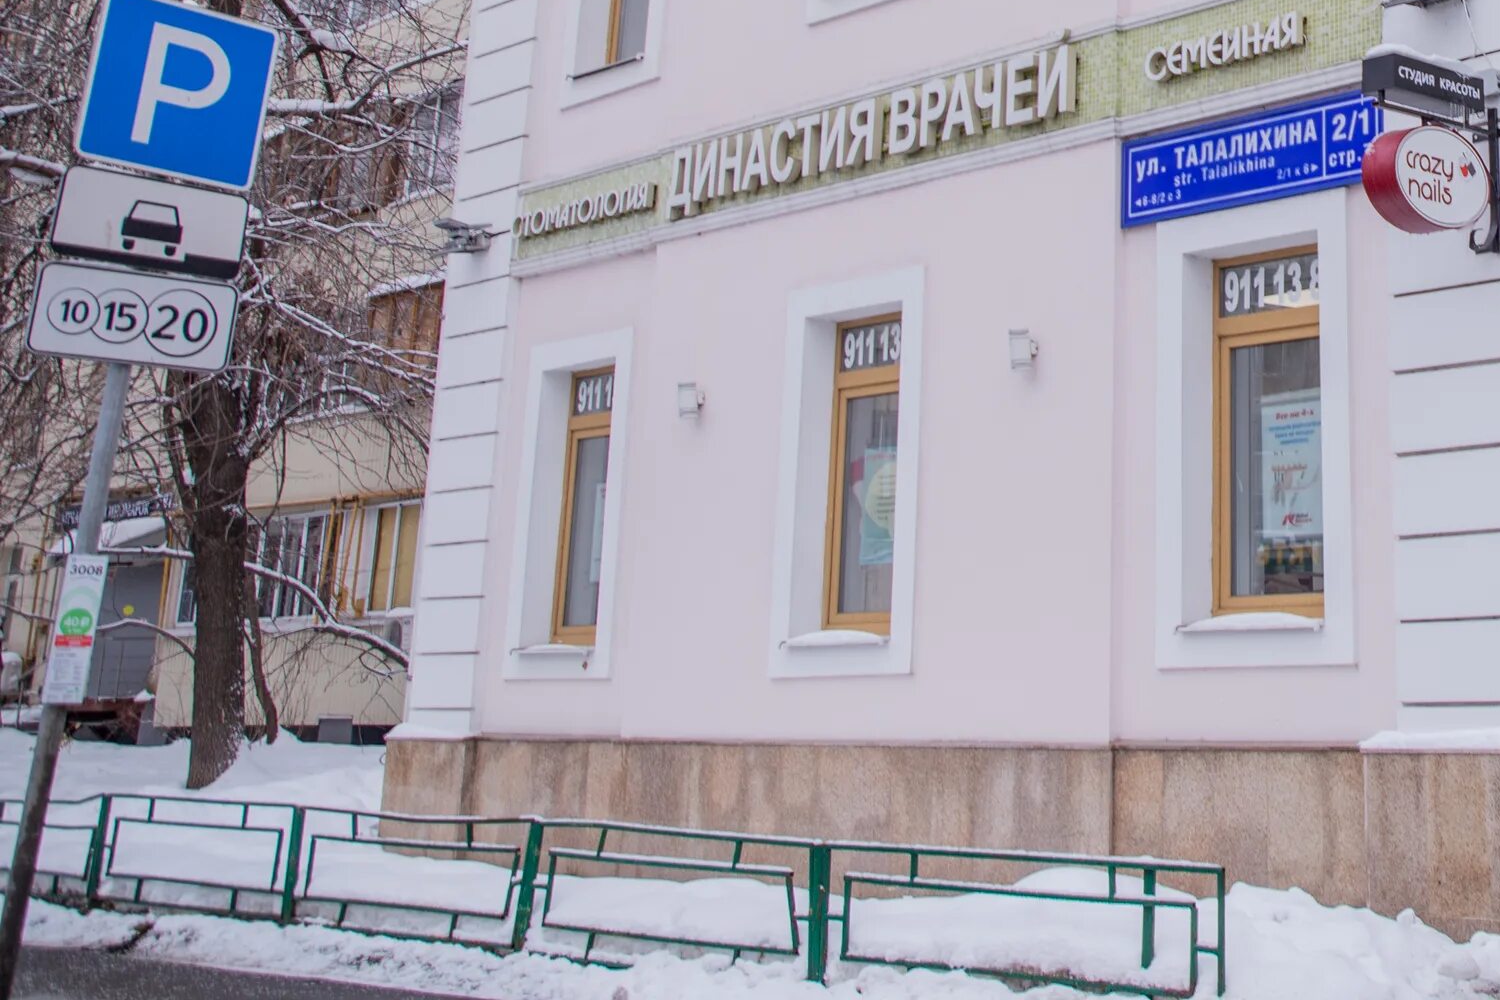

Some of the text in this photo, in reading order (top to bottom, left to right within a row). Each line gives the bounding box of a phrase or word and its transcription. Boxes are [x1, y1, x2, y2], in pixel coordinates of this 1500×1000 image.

[1144, 11, 1300, 82] СЕМЕЙНАЯ
[131, 22, 231, 144] P
[1398, 65, 1480, 100] СТУДИЯ КРАСОТЫ
[666, 28, 1074, 218] ДИНАСТИЯ ВРАЧЕЙ
[1331, 108, 1369, 141] 2/1
[1136, 119, 1317, 182] ул. ТАЛАЛИХИНА
[1328, 149, 1361, 168] стр.
[1406, 150, 1453, 181] crazy
[1174, 155, 1275, 187] str. Talalikhina
[512, 181, 651, 238] СТОМАТОЛОГИЯ
[1408, 178, 1452, 205] nails
[1224, 266, 1265, 312] 911
[60, 299, 209, 343] 10 15 20
[844, 326, 875, 369] 911
[577, 378, 601, 414] 911
[70, 564, 104, 577] 3008
